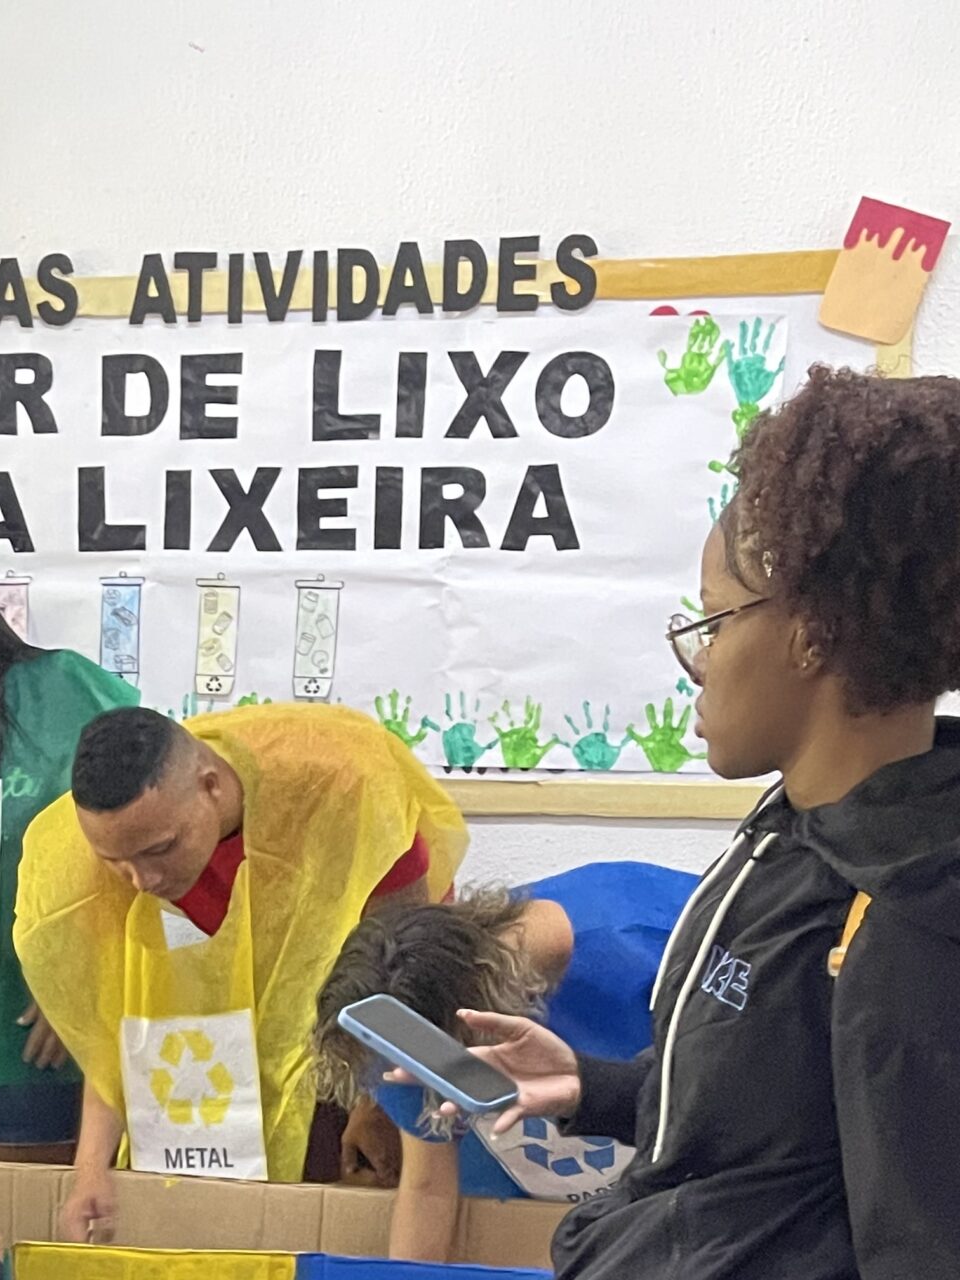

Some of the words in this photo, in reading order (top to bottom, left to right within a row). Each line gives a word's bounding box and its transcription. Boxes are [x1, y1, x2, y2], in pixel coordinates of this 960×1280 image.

[129, 234, 599, 325] ATIVIDADES
[100, 352, 244, 440] DE
[312, 349, 616, 441] LIXO
[77, 464, 581, 552] LIXEIRA
[164, 1147, 234, 1169] METAL
